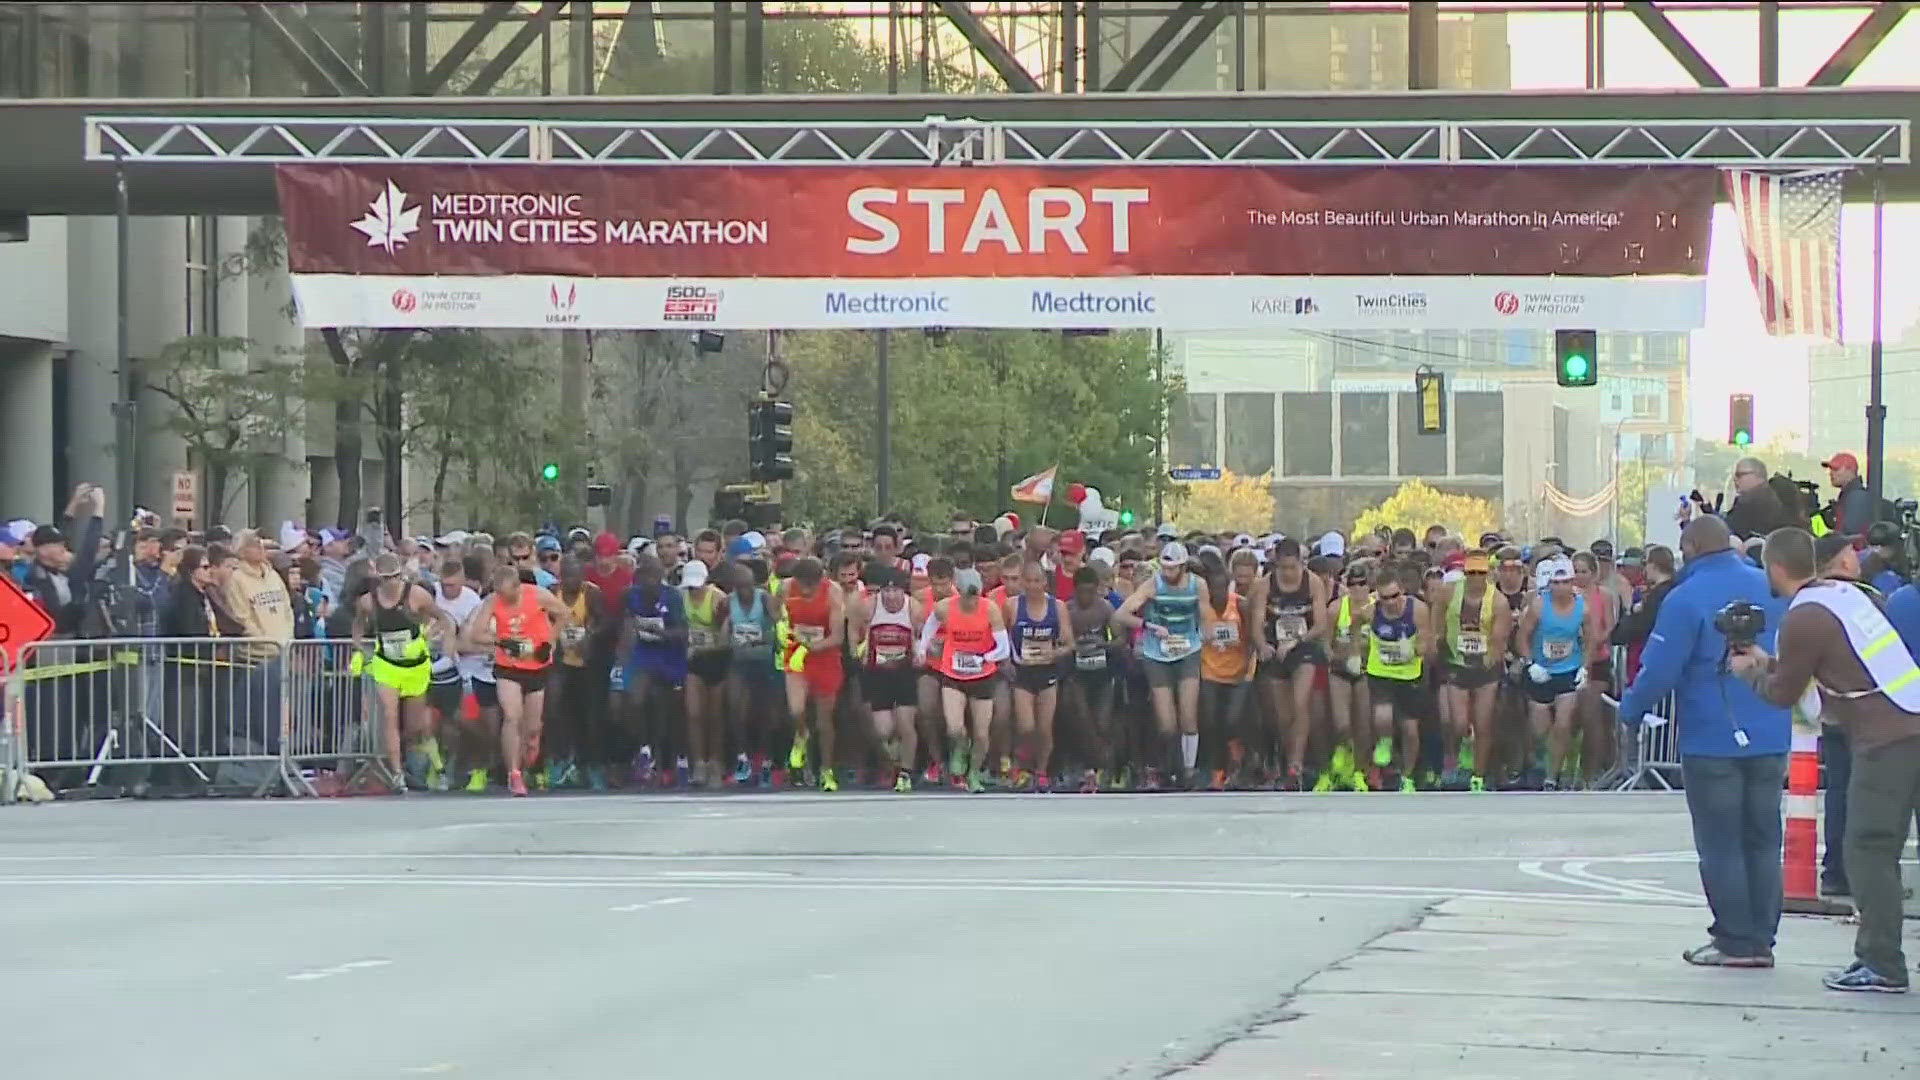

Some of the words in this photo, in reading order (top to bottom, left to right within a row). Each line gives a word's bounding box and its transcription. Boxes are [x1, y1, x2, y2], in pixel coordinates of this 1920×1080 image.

[433, 194, 582, 216] MEDTRONIC
[846, 187, 1150, 255] START
[1247, 209, 1277, 226] The
[1282, 209, 1320, 226] Most
[1325, 209, 1396, 226] Beautiful
[1400, 210, 1449, 227] Urban
[1454, 209, 1530, 227] Marathon
[432, 219, 503, 243] TWIN
[510, 220, 598, 244] CITIES
[606, 221, 768, 245] MARATHON
[667, 286, 706, 298] 1500
[1356, 294, 1427, 308] TwinCities
[1524, 294, 1552, 303] TWIN
[1554, 294, 1585, 304] CITIES
[825, 291, 949, 314] Medtronic
[1031, 290, 1156, 313] Medtronic
[1251, 298, 1292, 314] KARE
[1524, 304, 1536, 313] IN
[1538, 304, 1580, 314] MOTION
